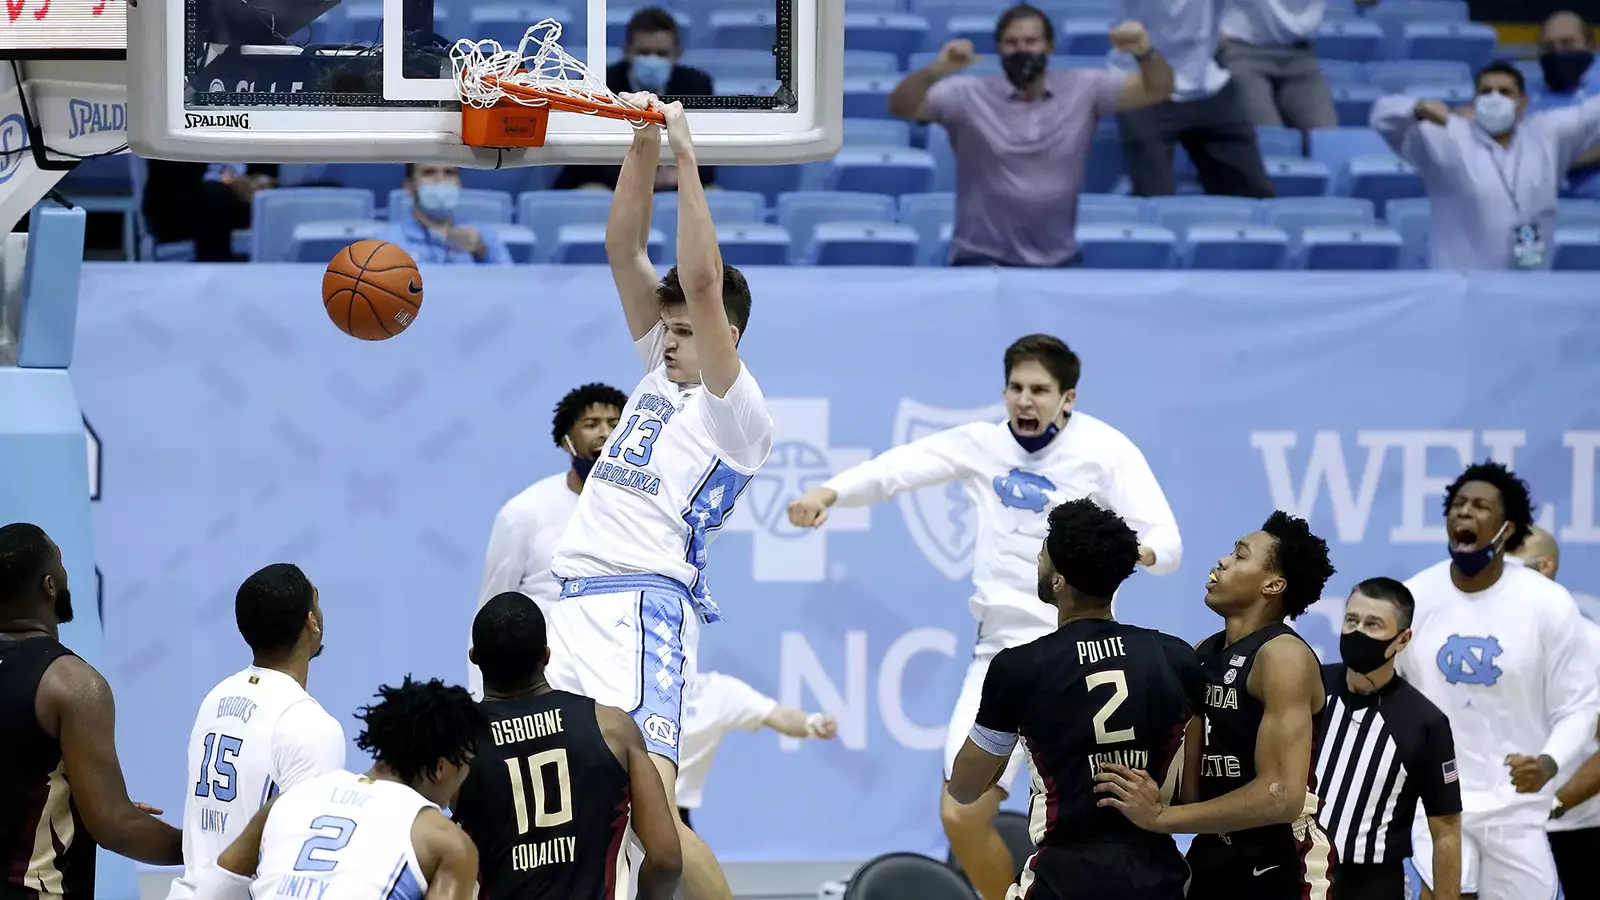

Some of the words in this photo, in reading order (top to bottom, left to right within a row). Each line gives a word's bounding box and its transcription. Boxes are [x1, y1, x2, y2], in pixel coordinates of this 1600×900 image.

[184, 113, 250, 129] SPALDING
[635, 393, 676, 424] NORTH
[608, 414, 662, 467] 13
[1076, 636, 1126, 665] POLITE
[778, 627, 957, 752] NC
[1085, 669, 1136, 744] 2
[216, 696, 257, 724] BROOKS
[491, 708, 564, 746] OSBORNE
[195, 732, 243, 803] 15
[329, 787, 376, 808] LOVE
[504, 748, 573, 835] 10
[201, 807, 229, 834] UNITY
[293, 815, 358, 872] 2
[512, 836, 576, 872] EQUALITY
[276, 875, 330, 900] UNITY
